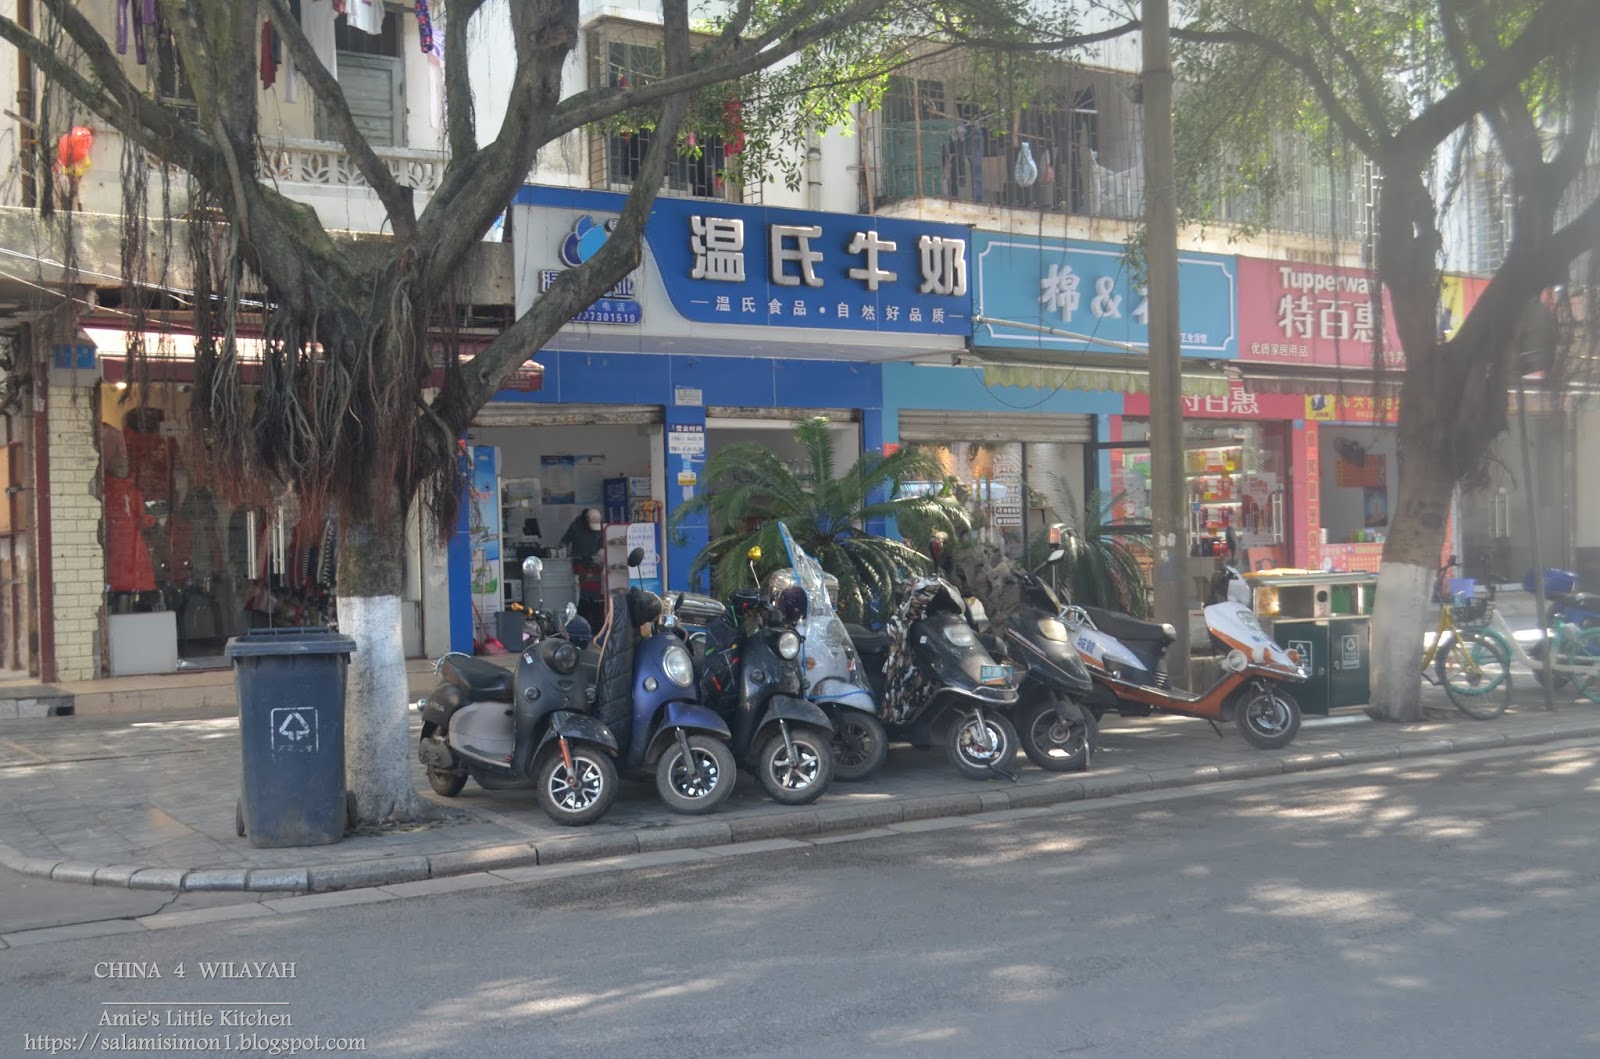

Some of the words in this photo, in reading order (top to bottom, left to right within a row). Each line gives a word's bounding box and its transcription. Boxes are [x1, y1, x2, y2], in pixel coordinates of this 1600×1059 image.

[690, 214, 967, 297] 温氏牛奶
[1279, 266, 1385, 295] Tupperwa
[1278, 293, 1387, 344] 特百惠
[1251, 342, 1309, 358] 优质家居用品
